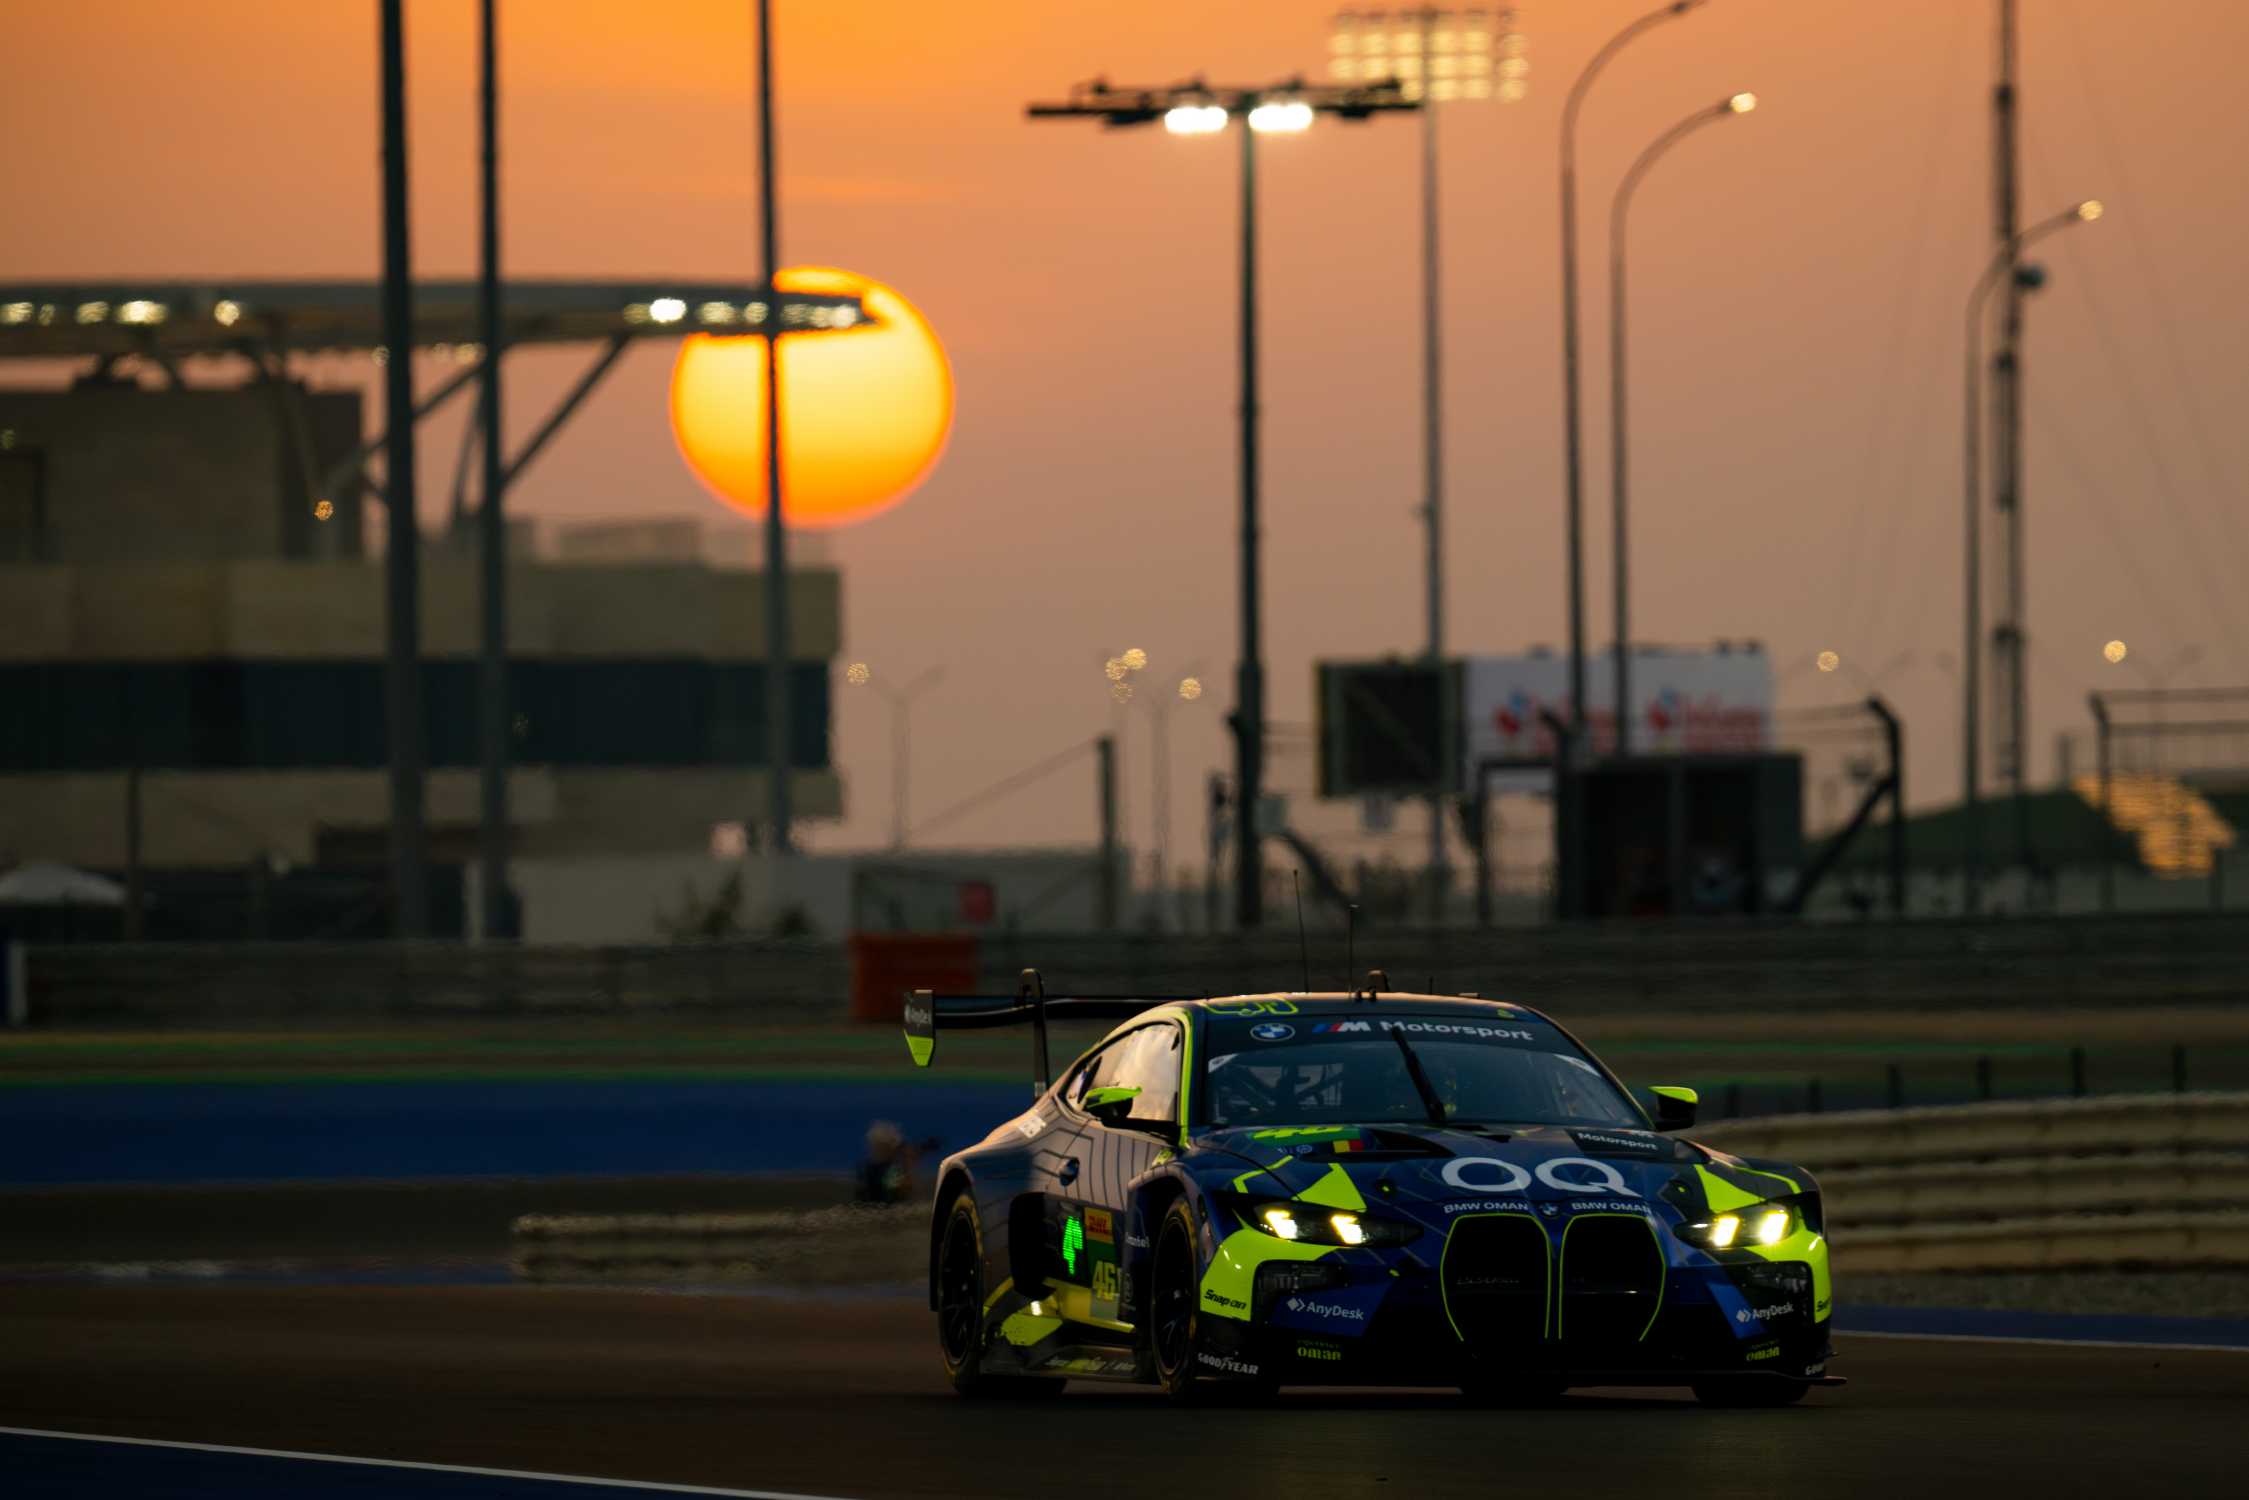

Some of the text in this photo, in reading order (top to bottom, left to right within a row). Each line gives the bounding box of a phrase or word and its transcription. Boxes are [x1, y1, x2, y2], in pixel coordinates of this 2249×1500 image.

[1379, 1021, 1534, 1041] Motorsport
[1577, 1132, 1659, 1151] Motorsport
[1441, 1157, 1643, 1198] OQ
[1443, 1201, 1529, 1214] BMW OMAN
[1571, 1202, 1607, 1210] BMW
[1306, 1301, 1365, 1320] AnyDesk
[1752, 1301, 1795, 1320] AnyDesk
[1197, 1352, 1260, 1375] GOODYEAR
